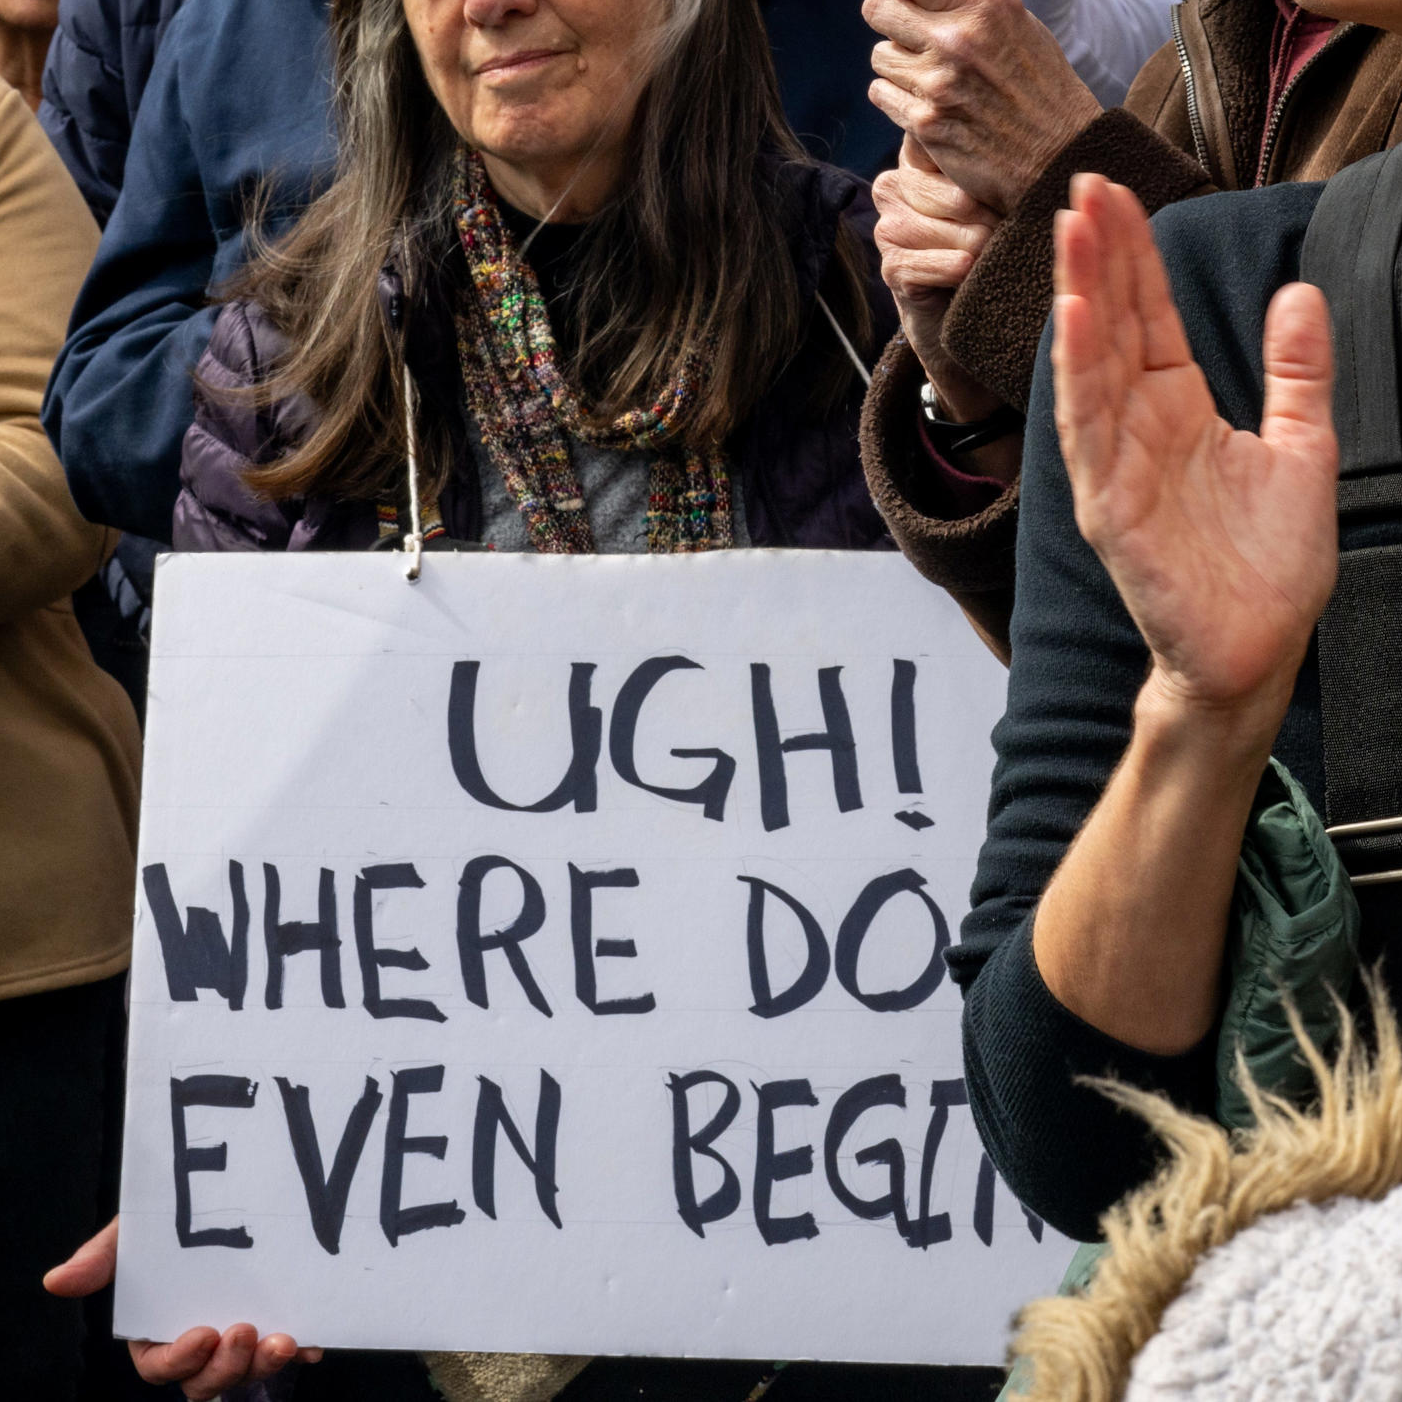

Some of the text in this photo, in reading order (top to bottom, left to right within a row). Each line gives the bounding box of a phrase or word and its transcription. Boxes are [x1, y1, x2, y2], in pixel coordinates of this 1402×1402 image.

[445, 654, 936, 832] UGH!
[141, 853, 953, 1023] WHERE DO
[169, 1062, 563, 1256] EVEN
